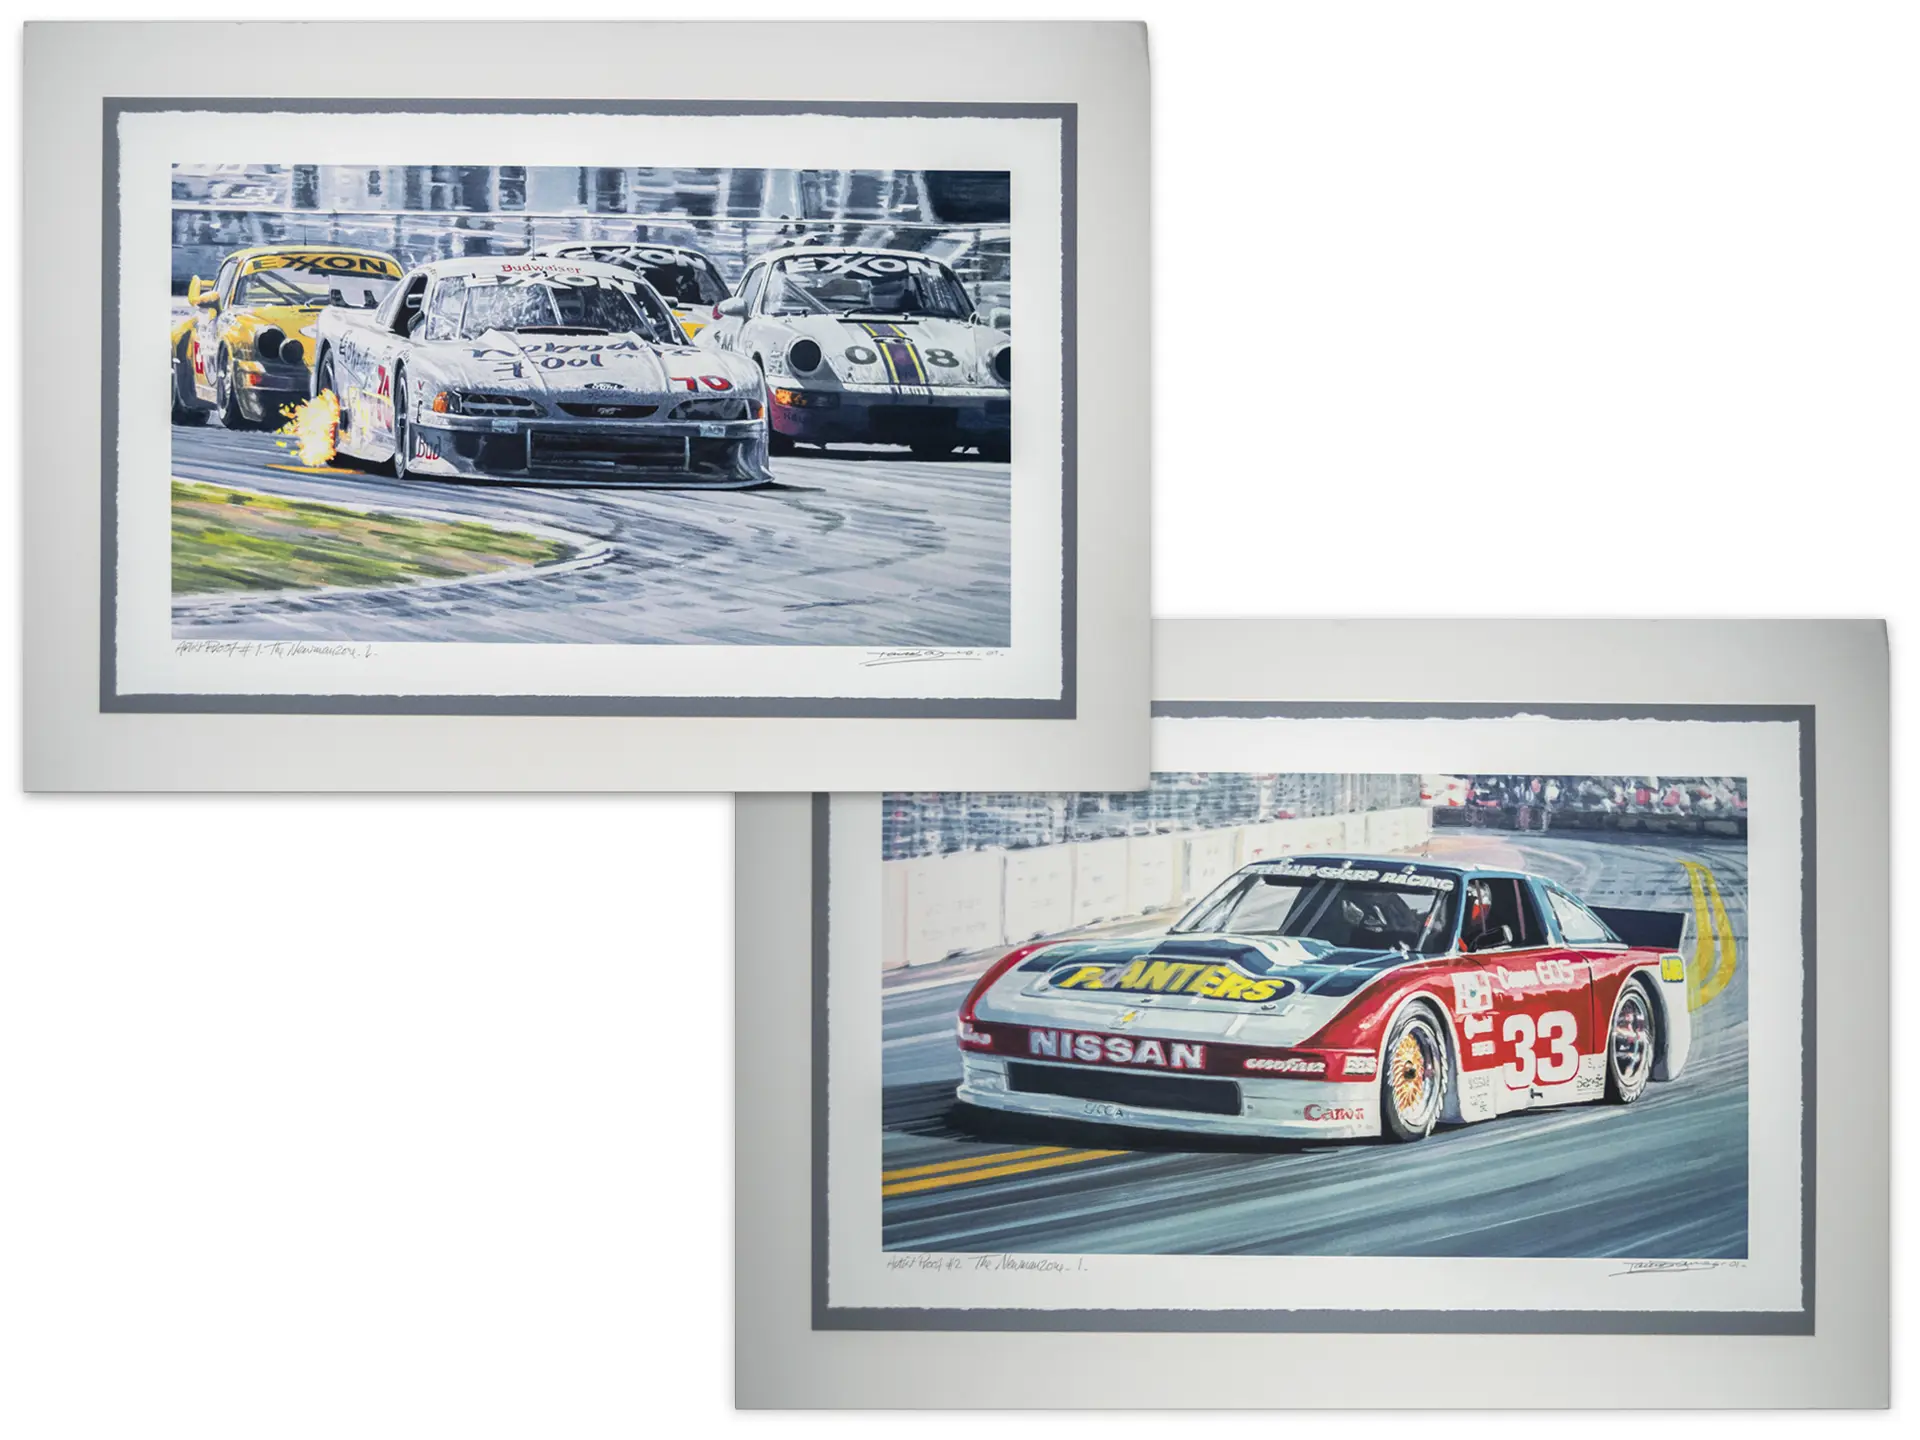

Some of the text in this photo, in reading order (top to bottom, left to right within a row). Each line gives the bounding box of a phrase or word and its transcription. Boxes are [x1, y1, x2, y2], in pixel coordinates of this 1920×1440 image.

[252, 255, 388, 274] EXXON
[501, 262, 585, 274] Budweiser
[785, 255, 942, 278] EXXON
[464, 273, 637, 295] EXXON
[670, 375, 734, 392] 70
[1379, 872, 1454, 892] RACING
[1059, 960, 1285, 1001] PLANTERS
[1029, 1028, 1206, 1070] NISSAN
[1503, 1009, 1580, 1092] 33
[968, 1254, 1001, 1270] The
